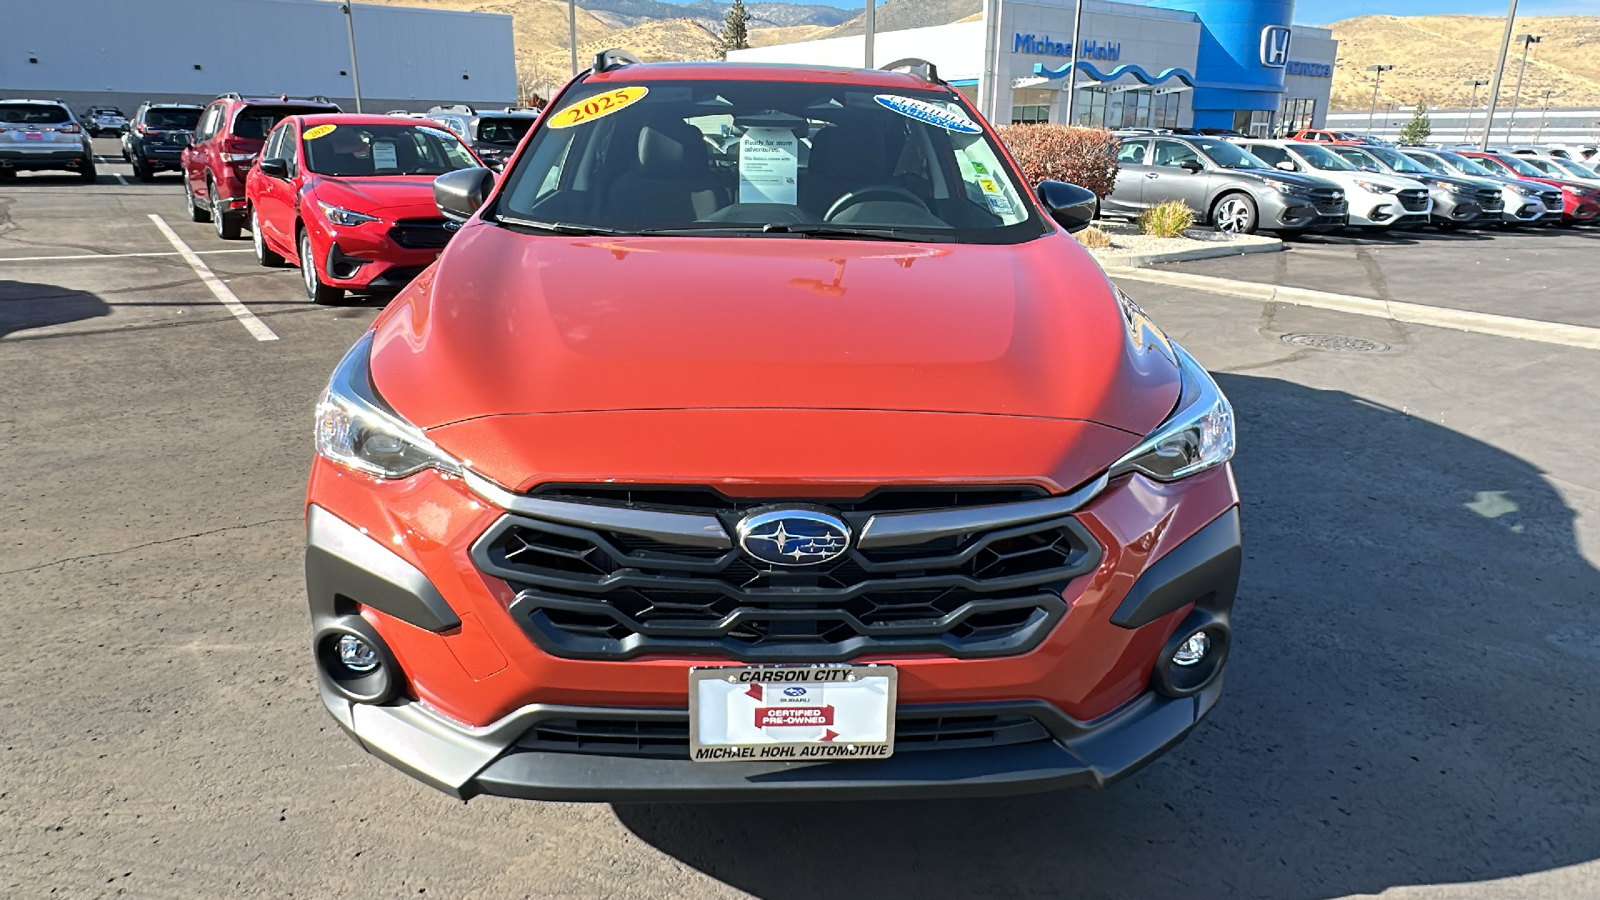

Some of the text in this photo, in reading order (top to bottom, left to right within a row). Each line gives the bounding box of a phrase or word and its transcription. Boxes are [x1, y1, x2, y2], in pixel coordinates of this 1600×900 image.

[1013, 32, 1121, 61] Michae Hohl
[567, 90, 629, 123] 2025
[739, 669, 852, 683] CARSON CITY
[762, 716, 827, 724] PRE-OWNED
[767, 709, 822, 717] CERTIFIED
[695, 744, 889, 760] MICHAEL HOHL AUTOMOTIVE
